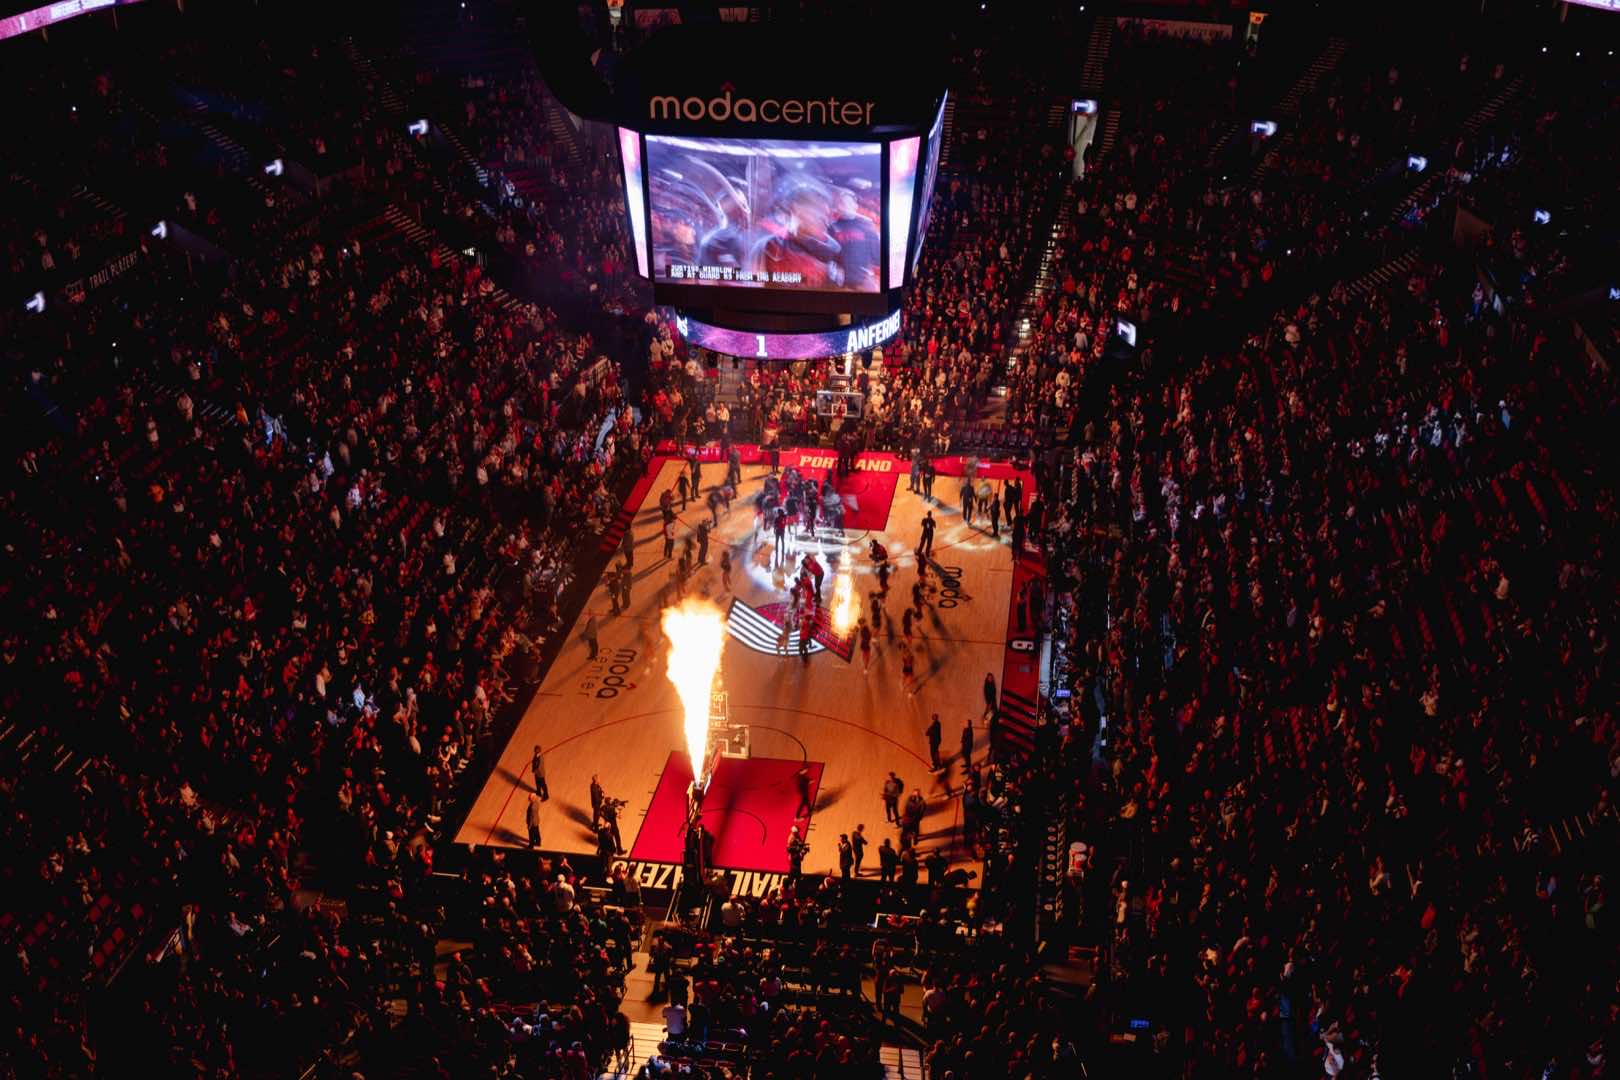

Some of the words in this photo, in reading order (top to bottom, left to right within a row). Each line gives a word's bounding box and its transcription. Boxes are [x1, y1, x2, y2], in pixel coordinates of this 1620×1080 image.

[650, 91, 875, 125] modacenter
[756, 335, 768, 357] 1
[799, 455, 893, 472] PORAND
